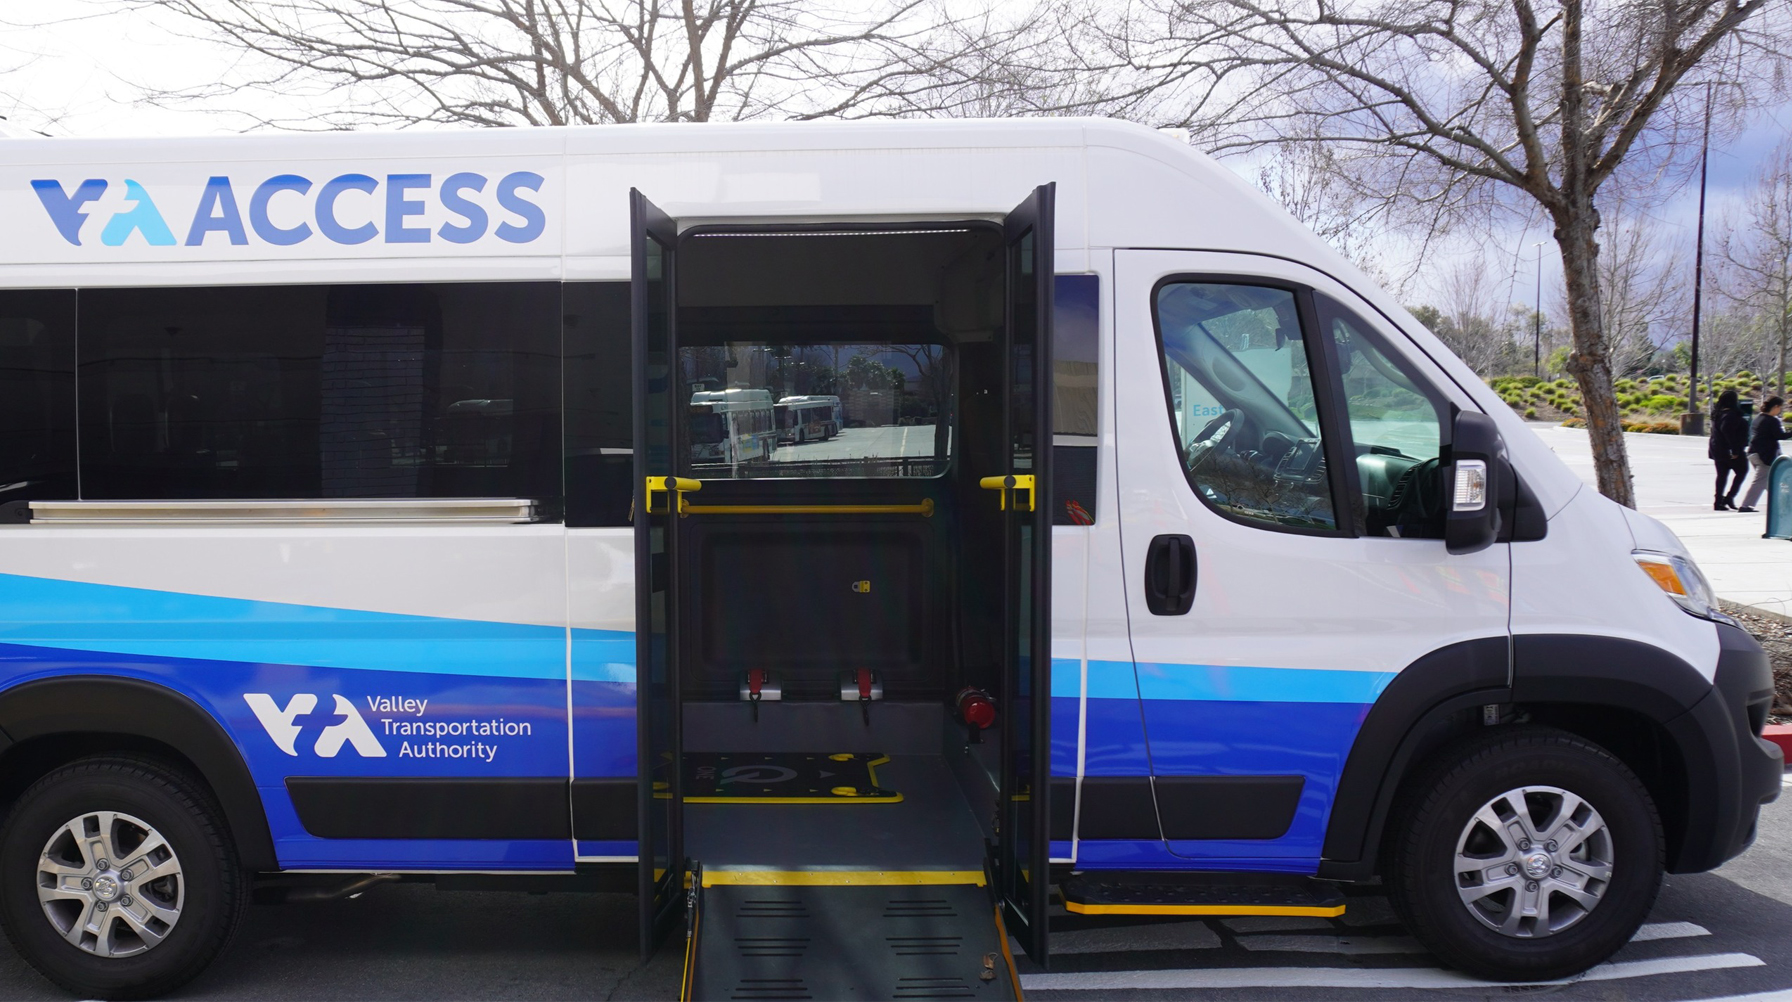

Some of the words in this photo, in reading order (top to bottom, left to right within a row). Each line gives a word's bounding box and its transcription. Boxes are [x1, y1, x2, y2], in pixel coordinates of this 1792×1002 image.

[184, 171, 546, 246] ACCESS
[1193, 404, 1223, 416] East
[366, 695, 428, 717] Valley
[381, 718, 532, 739] Transportation
[398, 740, 498, 763] Authority
